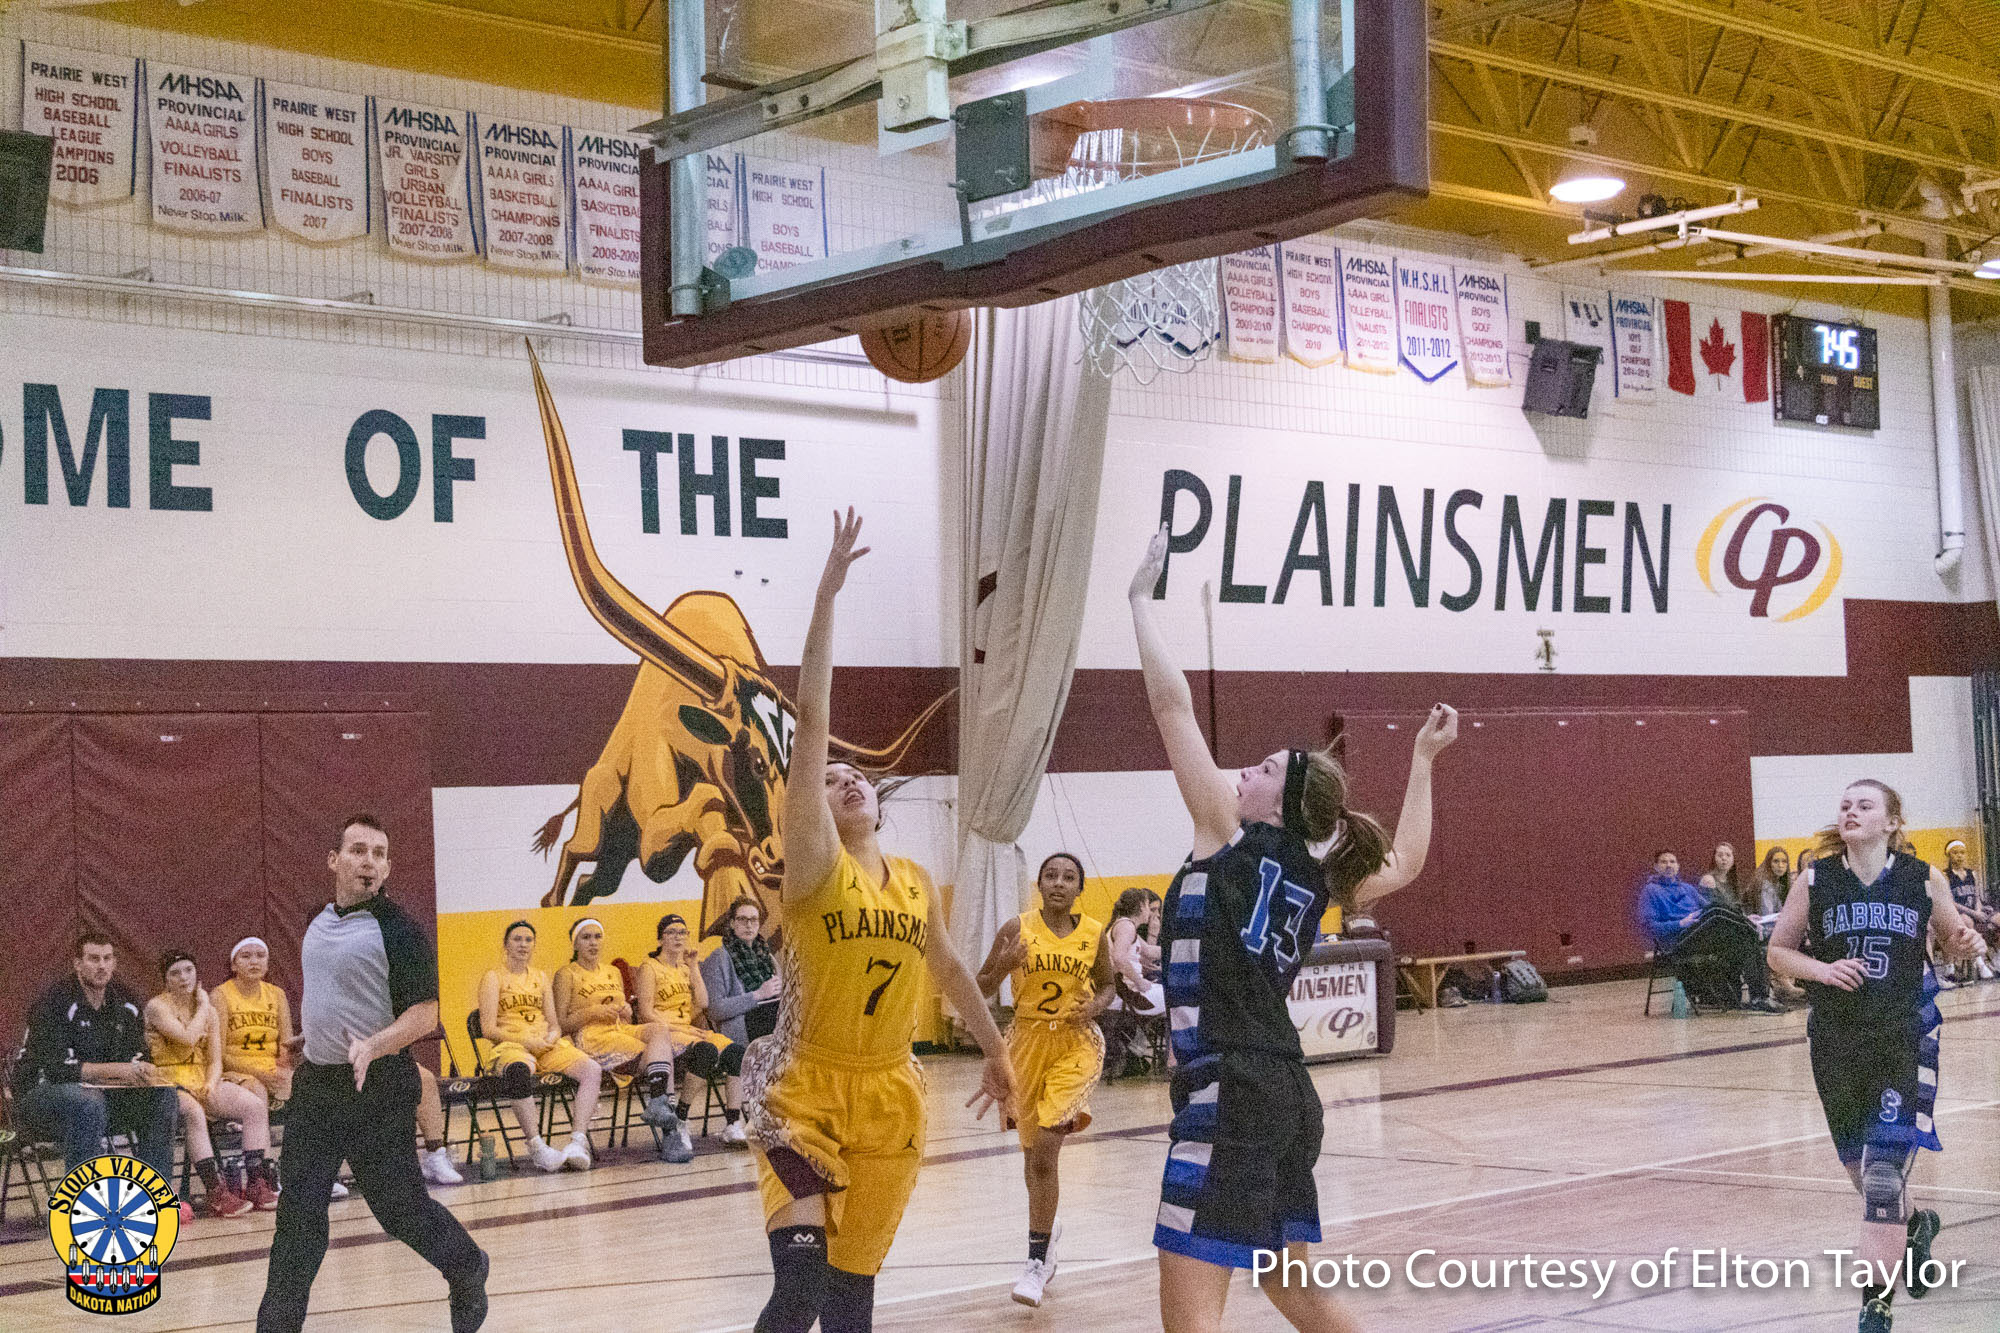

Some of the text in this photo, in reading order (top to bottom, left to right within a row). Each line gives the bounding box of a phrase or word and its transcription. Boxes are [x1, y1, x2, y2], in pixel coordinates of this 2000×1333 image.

[31, 61, 128, 89] PRAIRIE WEST
[159, 72, 244, 103] MHSAA
[35, 87, 121, 112] HIGH SCHOOL
[44, 107, 111, 128] BASEBALL
[158, 98, 246, 122] PROVINCIAL
[273, 97, 357, 123] PRAIRIE WEST
[165, 117, 239, 140] AAAA GIRLS
[384, 107, 460, 137] MHSAA
[52, 127, 102, 145] LEAGUE
[277, 121, 354, 146] HIGH SCHOOL
[384, 130, 461, 154] PROVINCIAL
[484, 123, 559, 150] MHSAA
[55, 146, 115, 165] AMPIONS
[160, 141, 242, 162] VOLLEYBALL
[301, 147, 333, 164] BOYS
[385, 145, 461, 166] JR. VARSITY
[485, 146, 556, 167] PROVINCIAL
[56, 164, 100, 185] 2006
[164, 162, 241, 183] FINALISTS
[404, 162, 440, 180] GIRLS
[487, 165, 554, 187] AAAA GIRLS
[578, 156, 640, 176] PROVINCIA
[292, 168, 341, 187] BASEBALL
[400, 178, 445, 195] URBAN
[577, 176, 640, 199] AAAA GIRL
[752, 172, 814, 191] PRAIRIE WEST
[281, 188, 354, 211] FINALISTS
[386, 190, 463, 211] VOLLEYBALL
[490, 188, 558, 208] BASKETBALL
[752, 189, 814, 209] HIGH SCHOOL
[159, 204, 188, 218] Never
[391, 207, 459, 227] FINALISTS
[491, 208, 560, 228] CHAMPIONS
[303, 214, 327, 229] 2007
[773, 224, 800, 238] BOYS
[761, 240, 813, 257] BASEBALL
[1225, 257, 1271, 272] PROVINCIAL
[1285, 250, 1332, 268] PRAIRIE WEST
[1346, 257, 1390, 277] MHSAA
[1250, 276, 1273, 287] GIRLS
[1346, 273, 1390, 288] PROVINCIAL
[1458, 274, 1501, 292] MHSAA
[1226, 286, 1276, 302] VOLLEYBALL
[1299, 288, 1320, 300] BOYS
[1458, 290, 1500, 304] PROVINCIAL
[1230, 302, 1275, 317] CHAMPIONS
[1292, 302, 1330, 318] BASEBALL
[1404, 299, 1449, 331] FINALISTS
[1471, 306, 1491, 318] BOYS
[1291, 320, 1333, 335] CHAMPIONS
[1471, 322, 1491, 332] GOLF
[1406, 336, 1451, 358] 2011-2012
[0, 382, 1671, 614] ME OF THE PLAINSMEN
[1240, 856, 1315, 973] 13
[1822, 902, 1919, 939] SABRES
[1847, 936, 1891, 979] 15
[1313, 962, 1364, 975] OF THE
[864, 956, 902, 1016] 7
[1037, 981, 1063, 1014] 2
